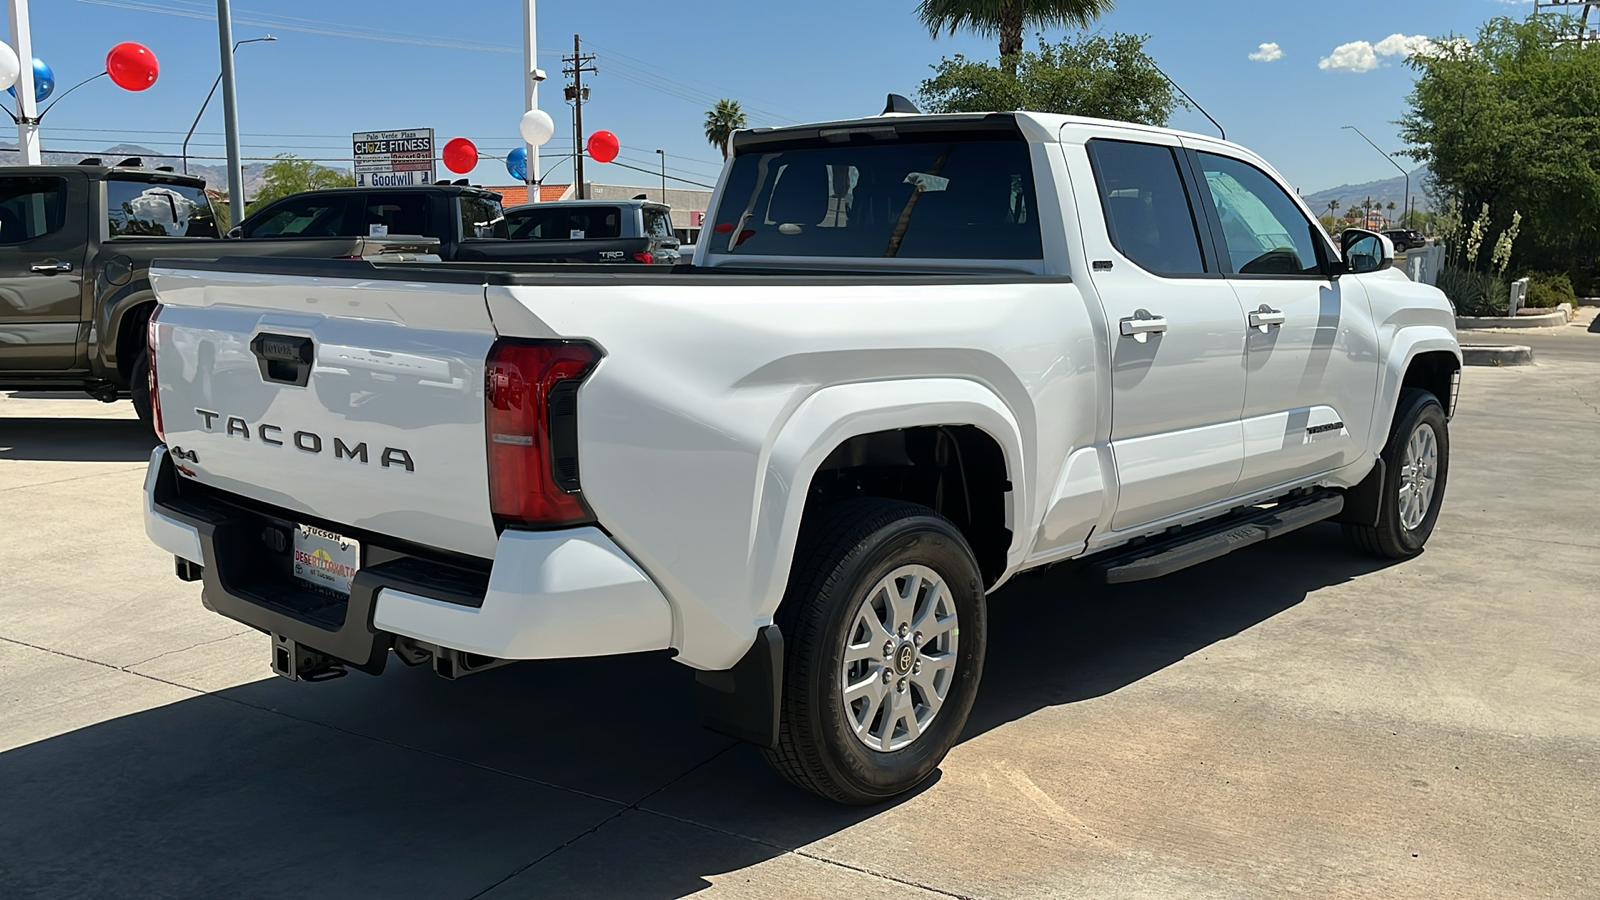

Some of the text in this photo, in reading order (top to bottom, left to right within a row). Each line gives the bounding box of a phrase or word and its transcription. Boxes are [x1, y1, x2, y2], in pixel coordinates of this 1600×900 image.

[389, 139, 430, 151] FITNESS
[372, 172, 413, 186] Goodwill
[264, 343, 293, 356] TOYOTA
[195, 408, 415, 472] TACOMA
[308, 527, 340, 541] TUCSON
[295, 550, 356, 578] DESERT TOYOTA
